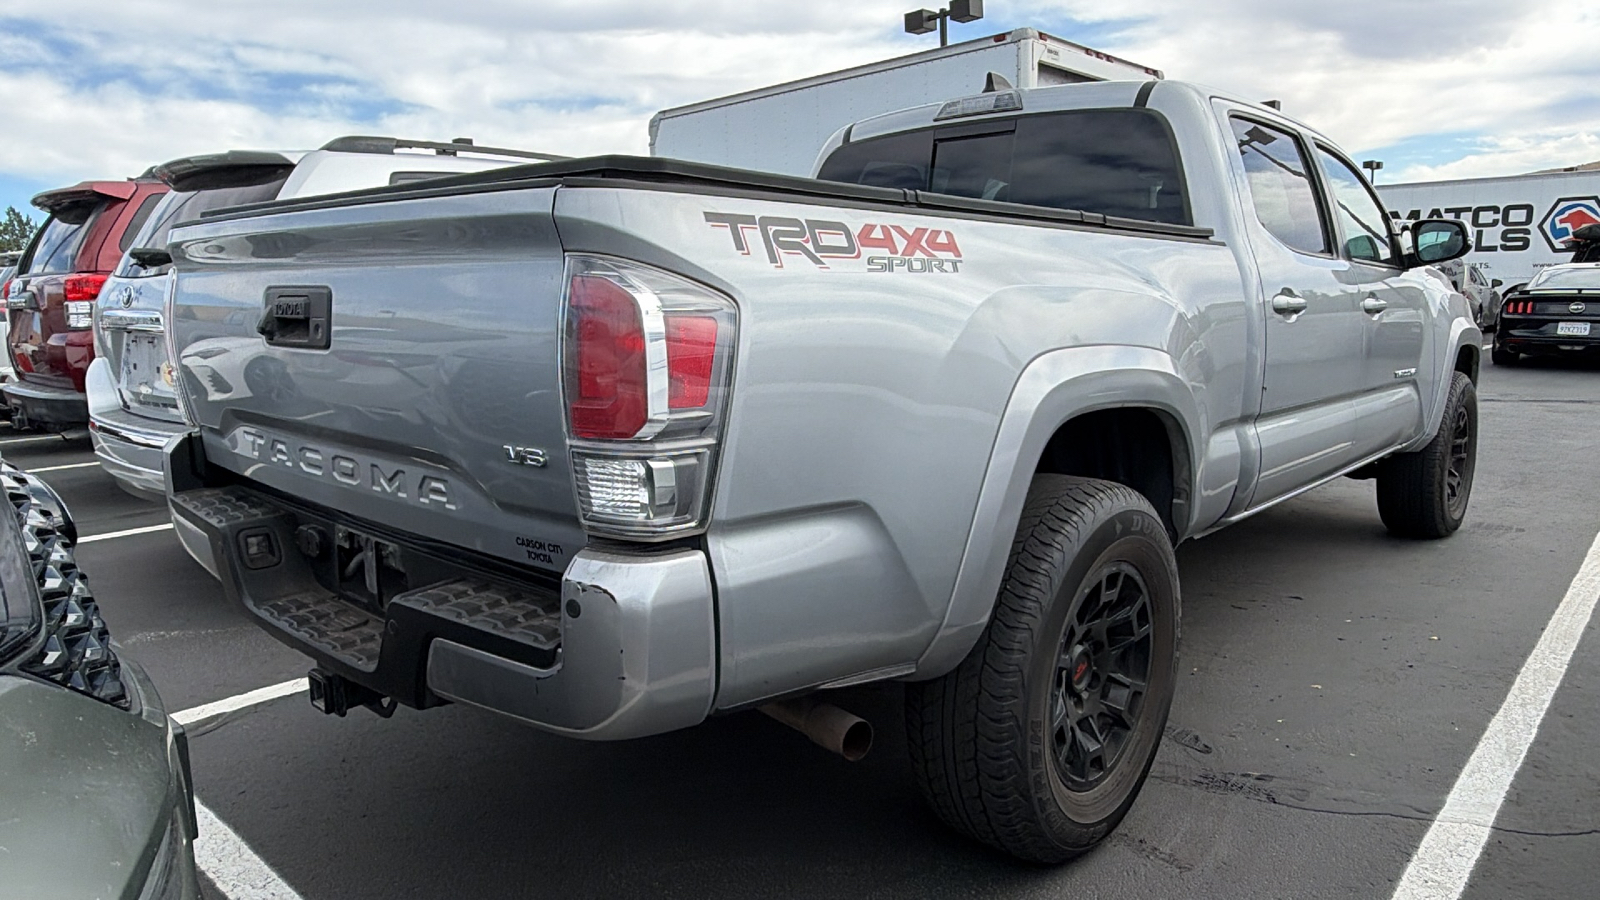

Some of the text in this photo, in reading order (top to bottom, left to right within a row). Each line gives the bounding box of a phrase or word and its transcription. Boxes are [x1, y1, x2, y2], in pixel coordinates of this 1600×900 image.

[703, 211, 861, 269] TRD
[867, 256, 962, 273] SPORT
[273, 301, 304, 316] TOYOTA
[503, 445, 548, 467] V6
[243, 430, 456, 510] TACOMA
[516, 537, 563, 555] CARSON CITY
[527, 550, 553, 564] TOYOTA
